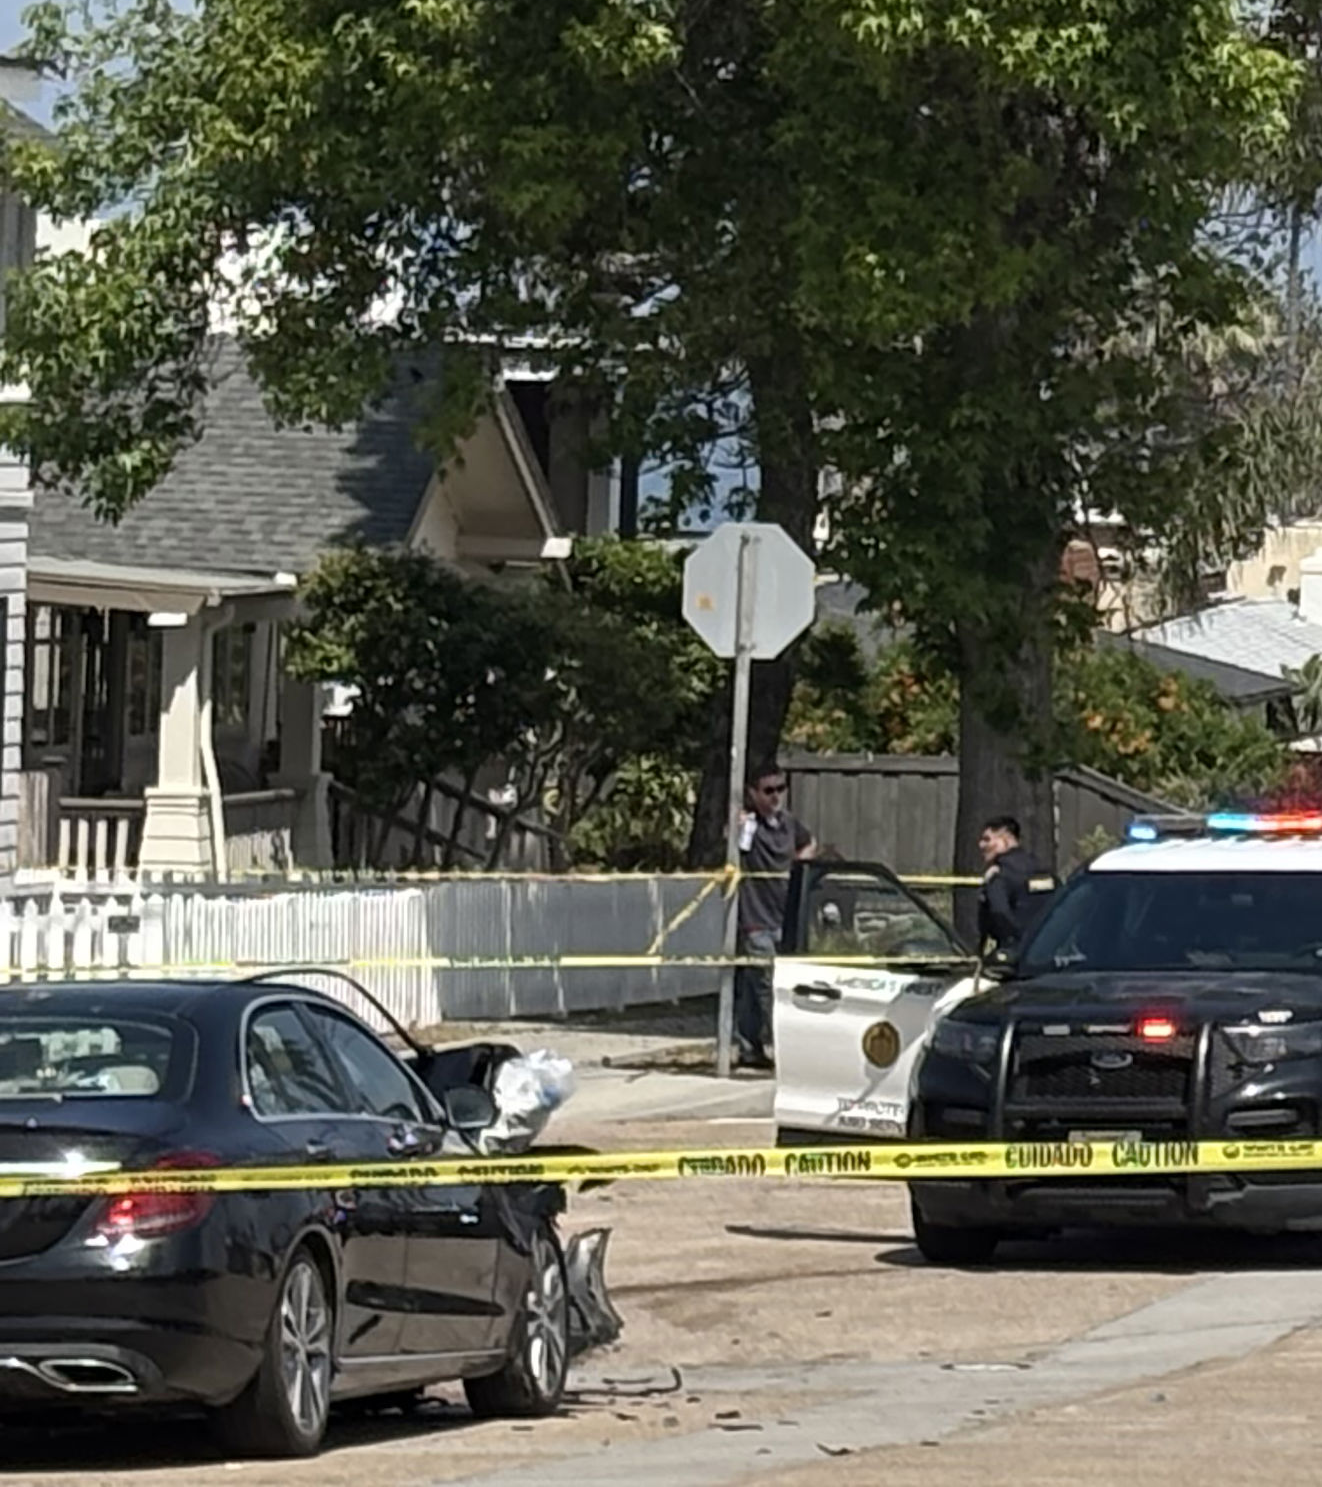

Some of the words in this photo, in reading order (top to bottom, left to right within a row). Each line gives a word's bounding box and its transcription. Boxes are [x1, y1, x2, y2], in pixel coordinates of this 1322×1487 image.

[784, 1150, 872, 1173] CAUTION
[1004, 1141, 1093, 1169] CUIDADO
[1112, 1139, 1200, 1169] CAUTION
